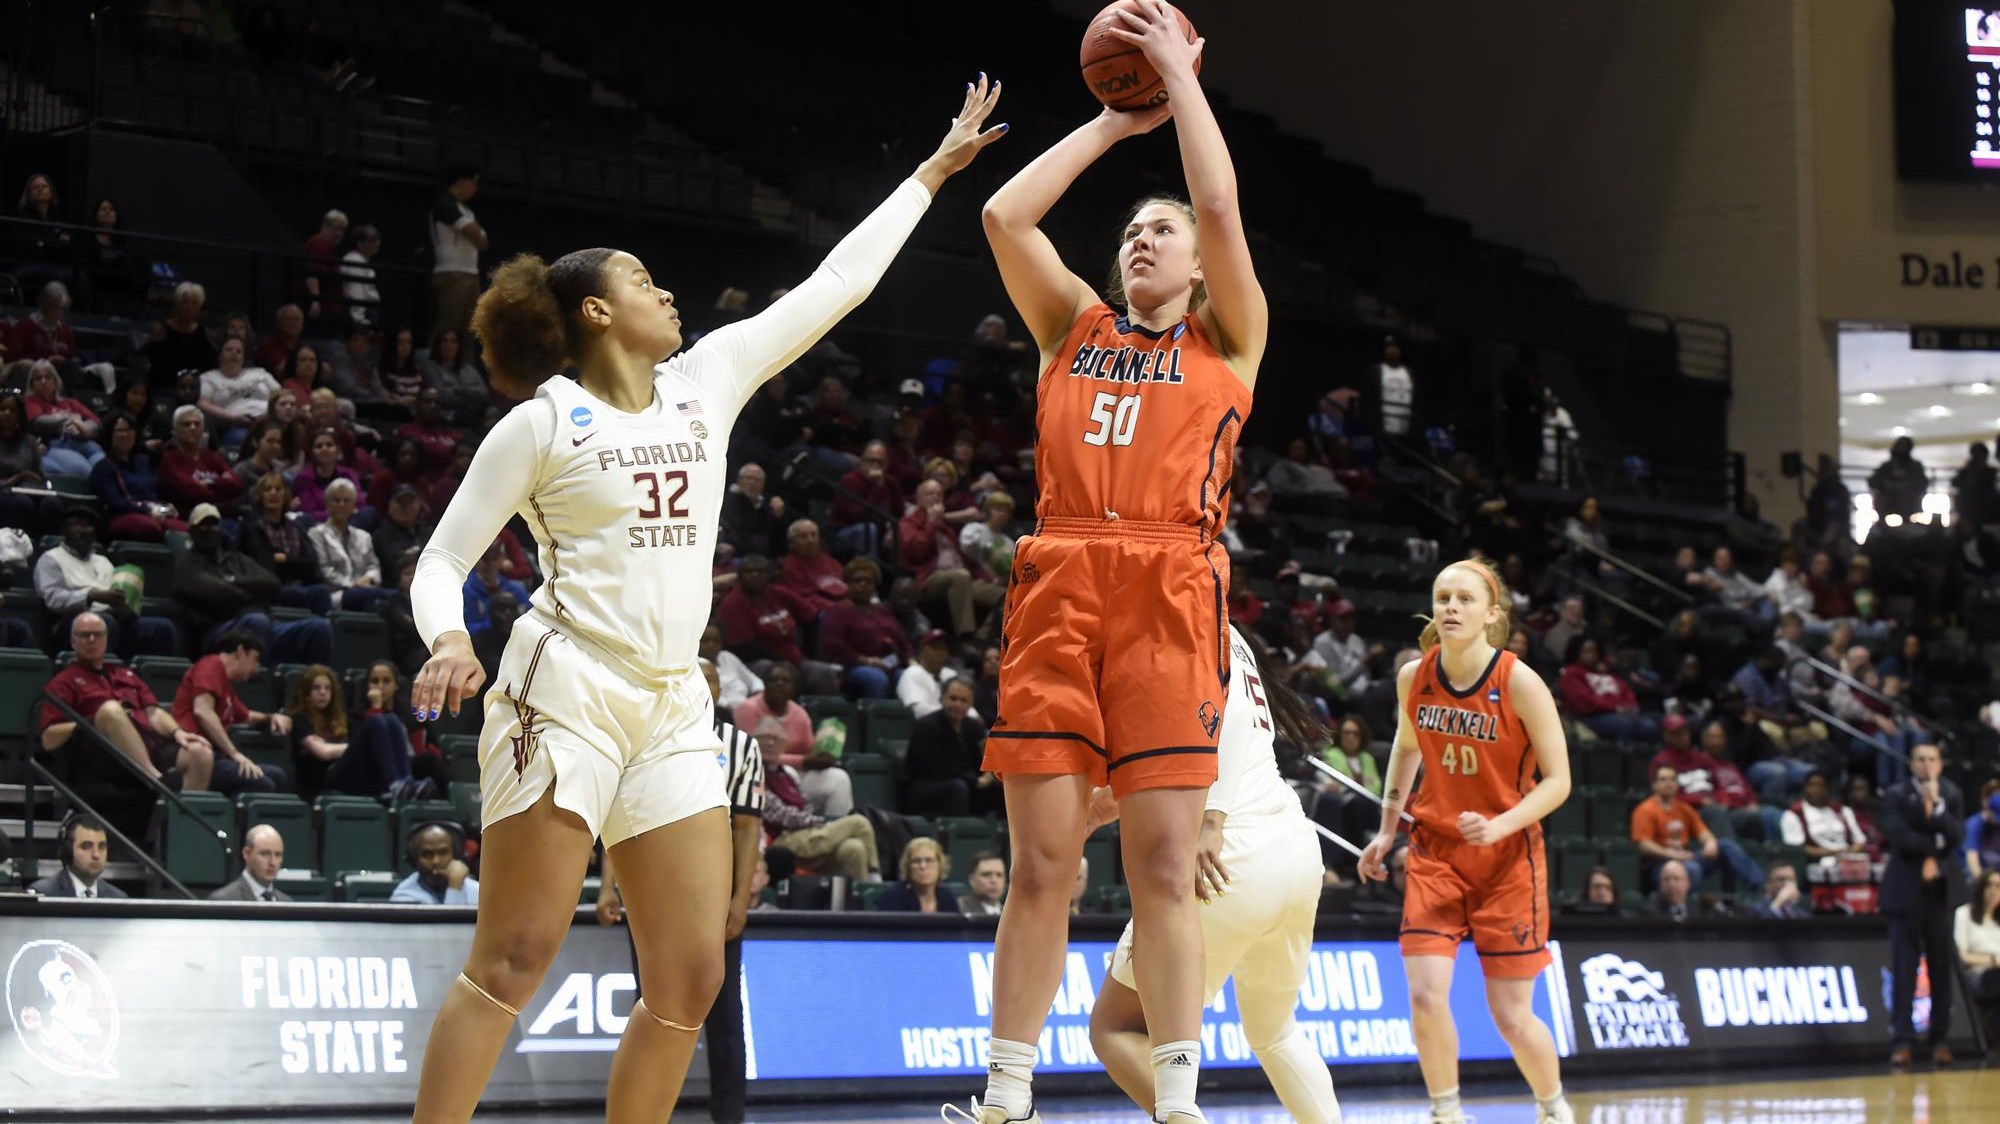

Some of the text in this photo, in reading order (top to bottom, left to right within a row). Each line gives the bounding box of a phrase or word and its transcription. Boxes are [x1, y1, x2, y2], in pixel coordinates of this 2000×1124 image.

[1900, 251, 1984, 287] Dale
[1069, 343, 1184, 385] BUCKNELL
[1083, 391, 1142, 446] 50
[597, 442, 707, 471] FLORIDA
[633, 470, 690, 520] 32
[629, 525, 697, 548] STATE
[1416, 705, 1498, 743] BUCKNELL
[1441, 743, 1478, 775] 40
[241, 956, 418, 1009] FLORIDA
[1294, 950, 1383, 1012] UND
[1695, 965, 1868, 1027] BUCKNELL
[528, 972, 638, 1034] AC
[1584, 1000, 1680, 1026] PATRIOT
[280, 1020, 408, 1074] STATE
[902, 1026, 991, 1069] HOSTE
[1590, 1023, 1690, 1049] LEAGUE
